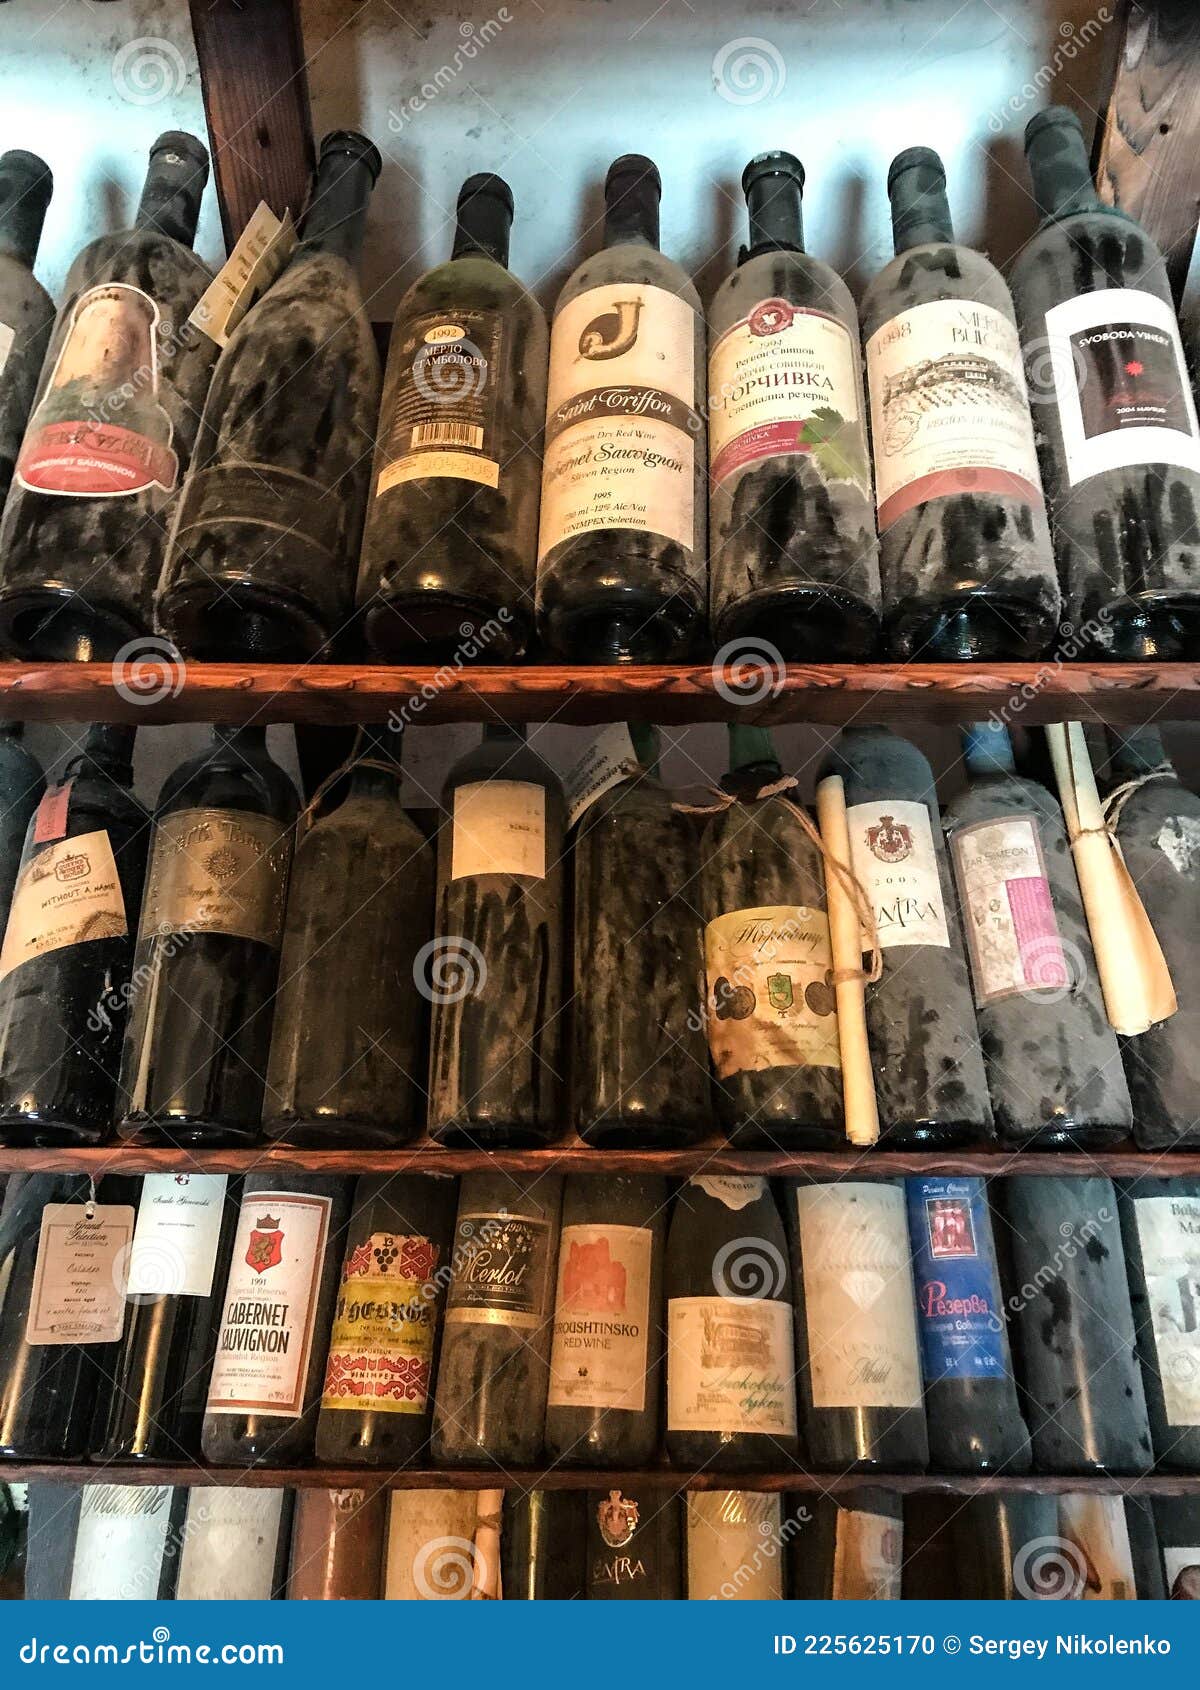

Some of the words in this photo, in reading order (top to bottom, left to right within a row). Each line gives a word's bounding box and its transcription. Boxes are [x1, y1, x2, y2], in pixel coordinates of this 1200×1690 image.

[431, 328, 459, 340] 1992
[1078, 330, 1136, 349] SVOBODA
[423, 344, 463, 357] МЕРЛО
[412, 354, 489, 372] СТАМБОЛОВО
[556, 394, 599, 424] Saint
[598, 387, 673, 415] Triffon
[615, 429, 633, 438] Red
[593, 442, 684, 474] Sauvignon
[600, 466, 636, 476] Region
[593, 490, 613, 501] 1995
[607, 514, 648, 526] Selection
[40, 888, 81, 909] WITHOUT
[84, 886, 92, 894] A
[94, 882, 117, 893] NAME
[462, 1249, 528, 1286] Merlot
[251, 1278, 267, 1287] 1991
[226, 1302, 290, 1328] CABERNET
[220, 1328, 291, 1355] SAUVIGNON
[563, 1336, 583, 1349] RED
[583, 1336, 613, 1351] WINE
[350, 1372, 396, 1380] VINIMPEX
